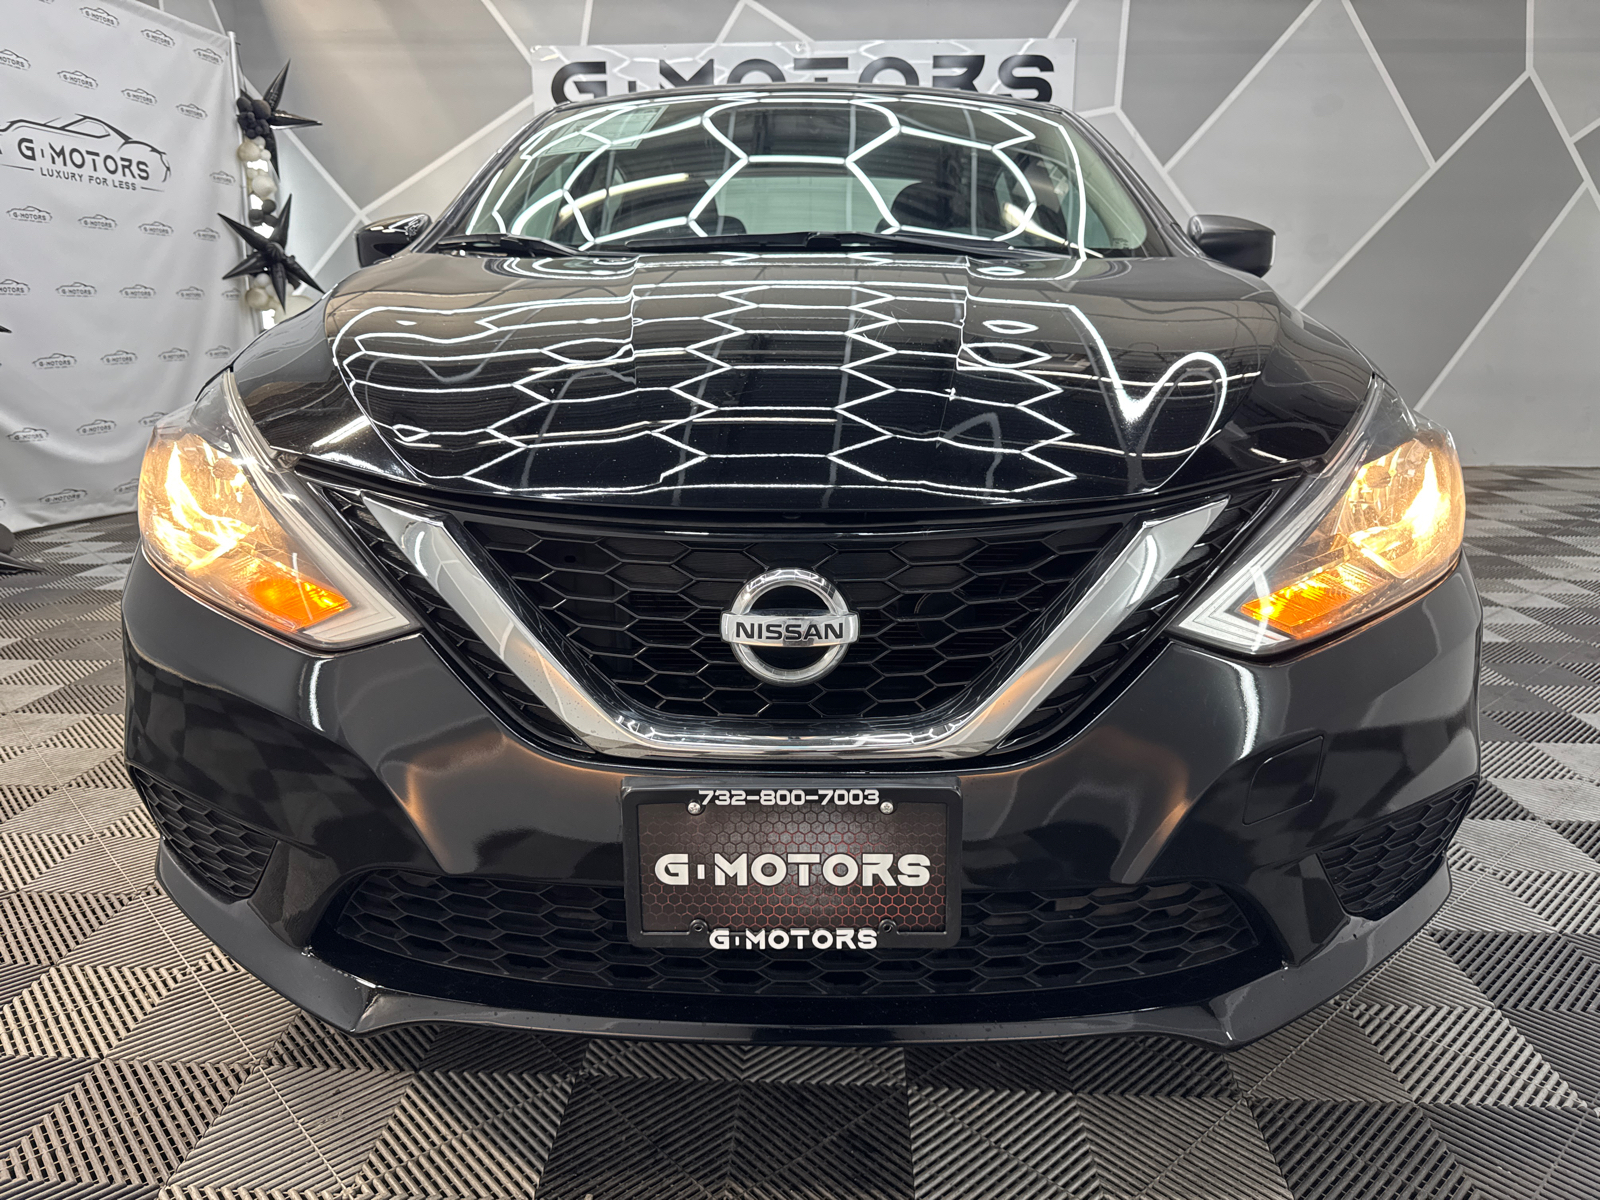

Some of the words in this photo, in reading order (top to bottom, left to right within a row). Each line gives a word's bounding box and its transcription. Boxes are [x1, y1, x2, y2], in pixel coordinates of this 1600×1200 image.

[40, 167, 85, 183] LUXURY
[88, 175, 110, 187] FOR
[112, 178, 137, 191] LESS
[735, 621, 844, 640] NISSAN
[698, 789, 880, 806] 732-800-7003
